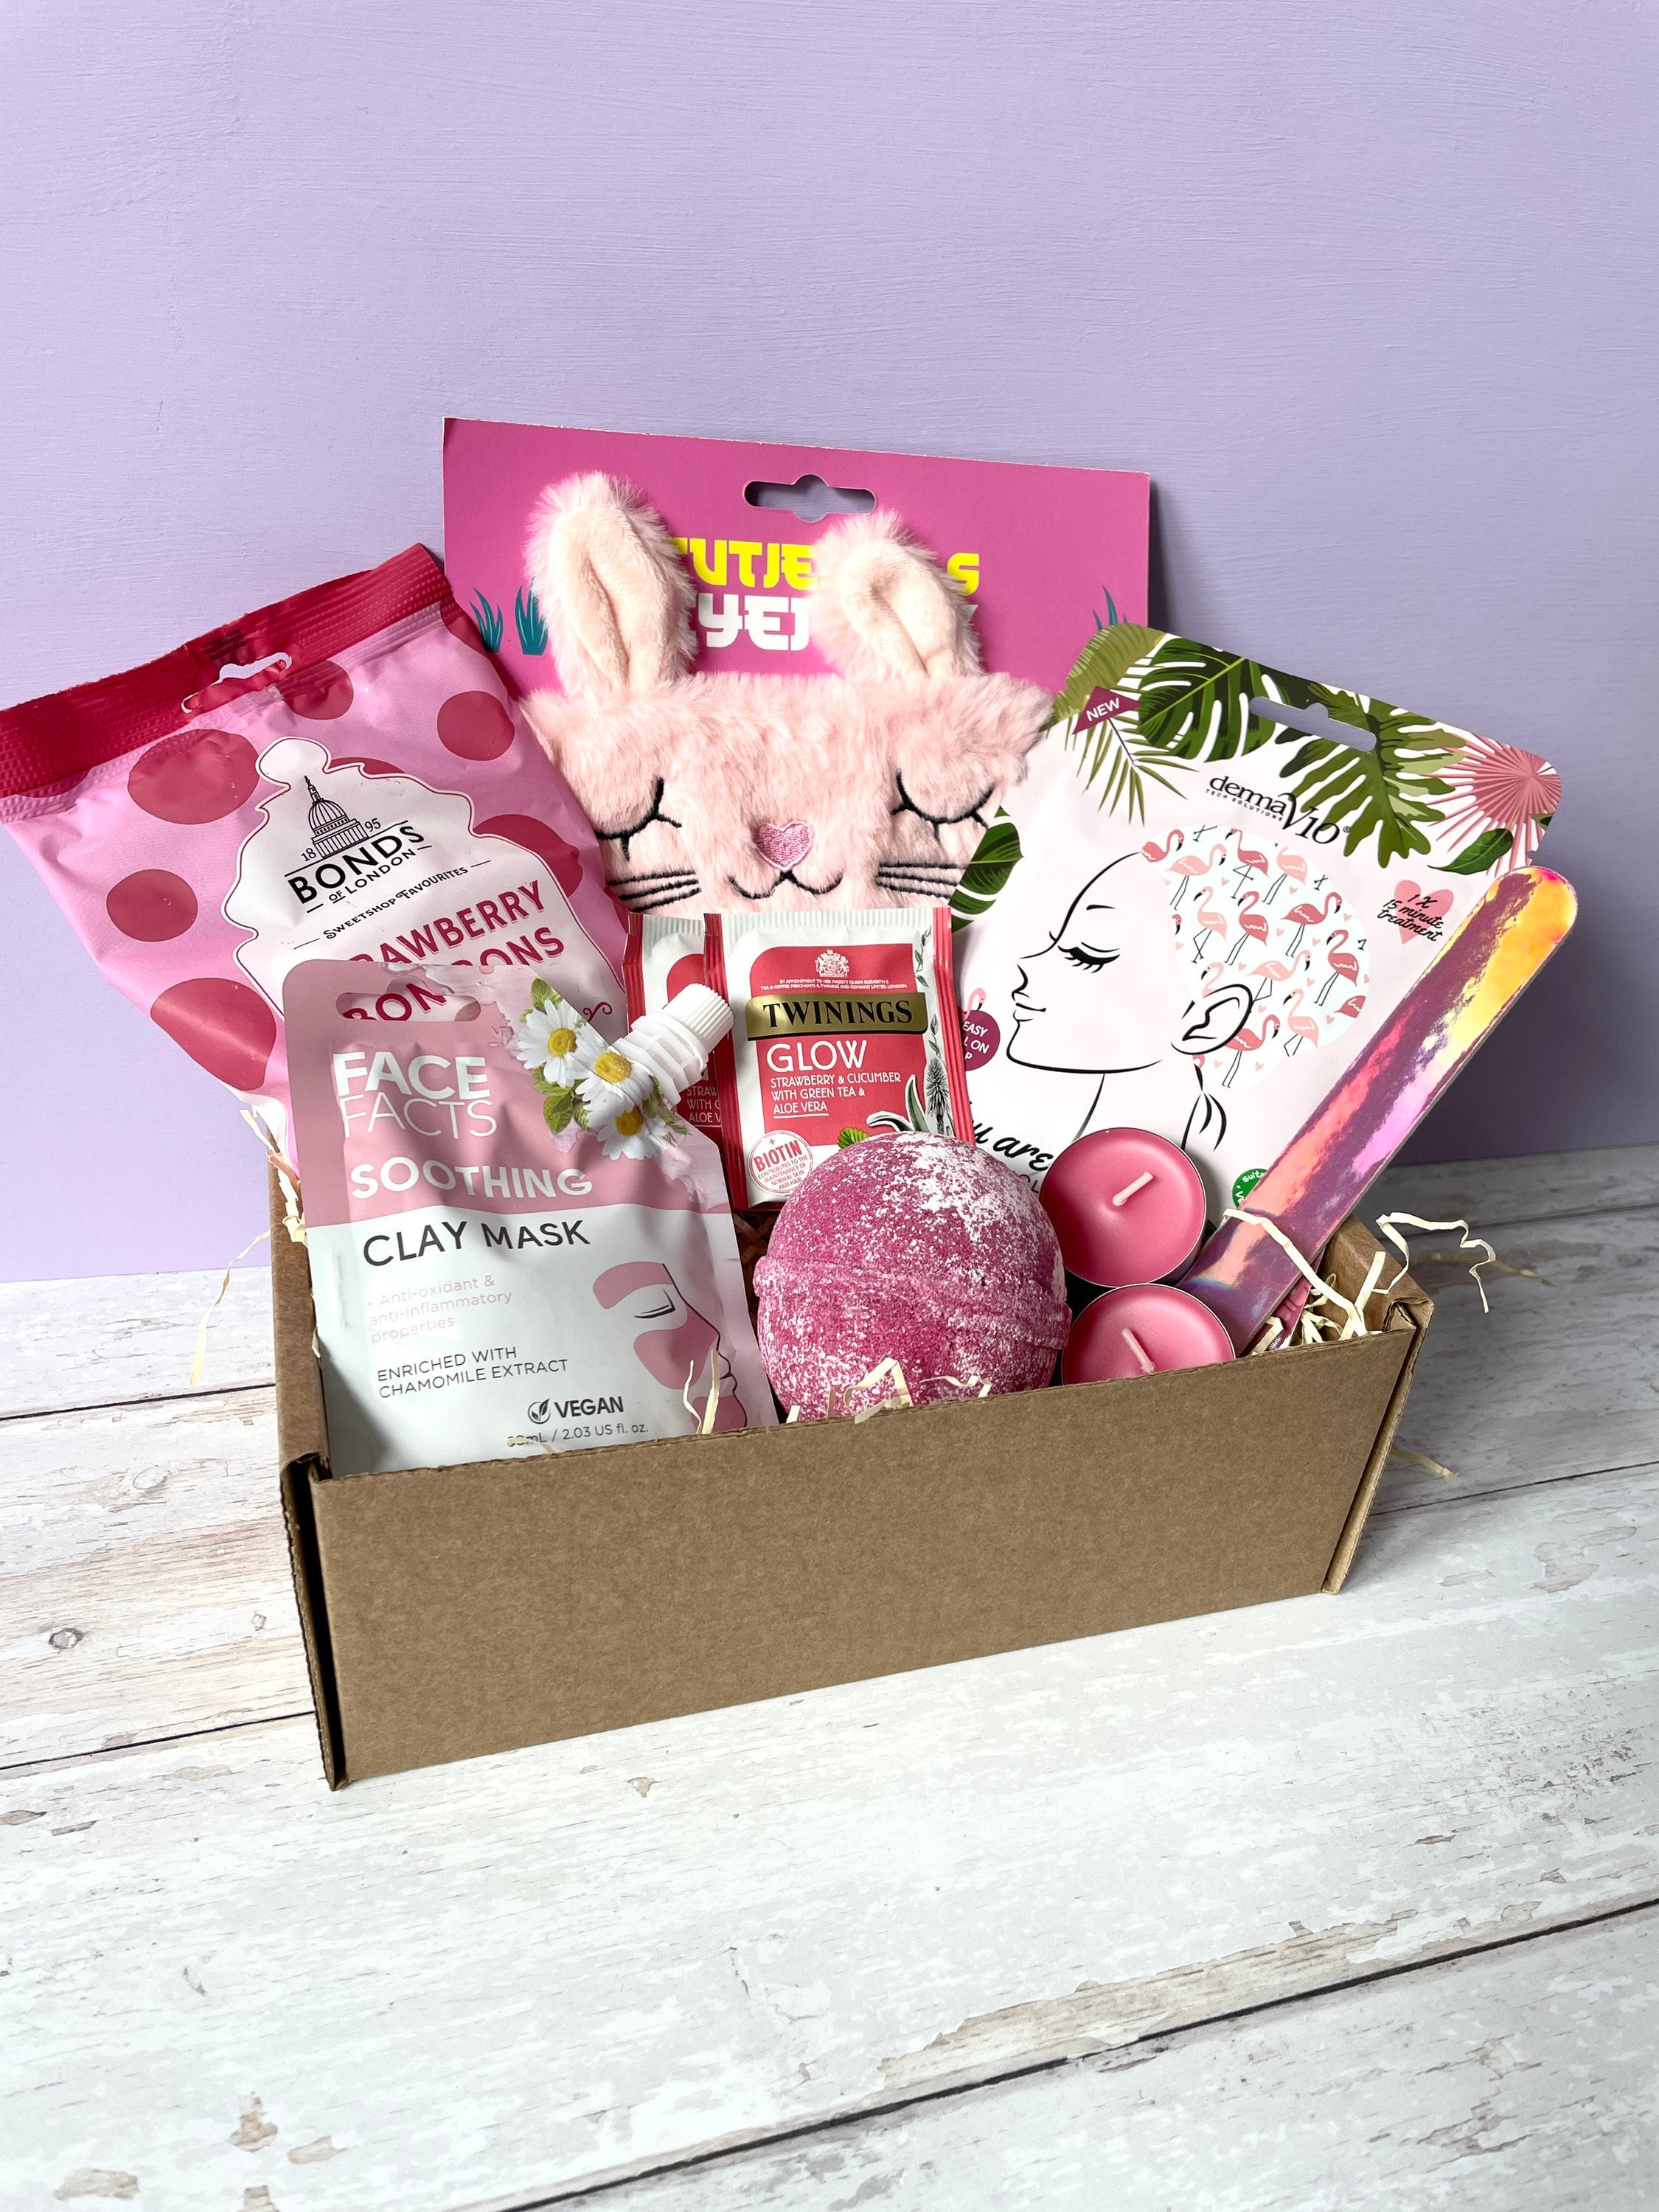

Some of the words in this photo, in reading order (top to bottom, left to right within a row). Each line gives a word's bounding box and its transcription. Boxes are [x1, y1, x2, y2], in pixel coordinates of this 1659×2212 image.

[1086, 698, 1119, 722] NEW
[1206, 788, 1228, 799] TECH
[1232, 798, 1283, 821] SOLUTIONS
[301, 848, 317, 862] 18
[364, 818, 381, 832] 95
[288, 826, 425, 904] BONDS
[329, 890, 343, 901] OF
[344, 849, 417, 894] LONDON
[349, 880, 546, 963] AWBERRY
[1377, 909, 1443, 942] treatment
[1383, 899, 1402, 909] 15
[1398, 906, 1444, 929] minute
[762, 1001, 913, 1028] TWININGS
[962, 1020, 988, 1037] EASY
[766, 1040, 867, 1072] GLOW
[970, 1040, 990, 1054] ON
[333, 1051, 490, 1100] FACE
[771, 1074, 835, 1088] STRAWBERRY
[838, 1075, 845, 1084] &
[847, 1072, 901, 1083] CUCUMBER
[687, 1099, 712, 1110] WITH
[771, 1089, 797, 1102] WITH
[800, 1088, 834, 1099] GREEN
[837, 1086, 856, 1097] TEA
[858, 1087, 866, 1096] &
[773, 1102, 799, 1114] ALOE
[801, 1101, 828, 1112] VERA
[339, 1091, 497, 1139] FACTS
[689, 1112, 713, 1122] ALOE
[754, 1140, 802, 1172] BIOTIN
[993, 1137, 1054, 1171] are
[350, 1156, 593, 1199] SOOTHING
[758, 1162, 791, 1180] CONTRIBUTES
[765, 1165, 799, 1183] MAINTENANCE
[771, 1174, 792, 1186] NORMAL
[779, 1181, 790, 1190] AND
[364, 1221, 467, 1266] CLAY
[481, 1220, 591, 1250] MASK
[378, 1278, 479, 1307] Anti-oxidant
[484, 1275, 495, 1287] &
[369, 1292, 512, 1326] anti-inflammatory
[371, 1317, 456, 1345] properties
[377, 1354, 466, 1382] ENRICHED
[471, 1346, 517, 1363] WITH
[379, 1368, 487, 1399] CHAMOMILE
[492, 1359, 568, 1378] EXTRACT
[554, 1396, 625, 1418] VEGAN
[552, 1429, 558, 1443] /
[563, 1426, 591, 1440] 2.03
[595, 1424, 613, 1436] US
[616, 1423, 628, 1434] fl.
[631, 1424, 649, 1433] oz.
